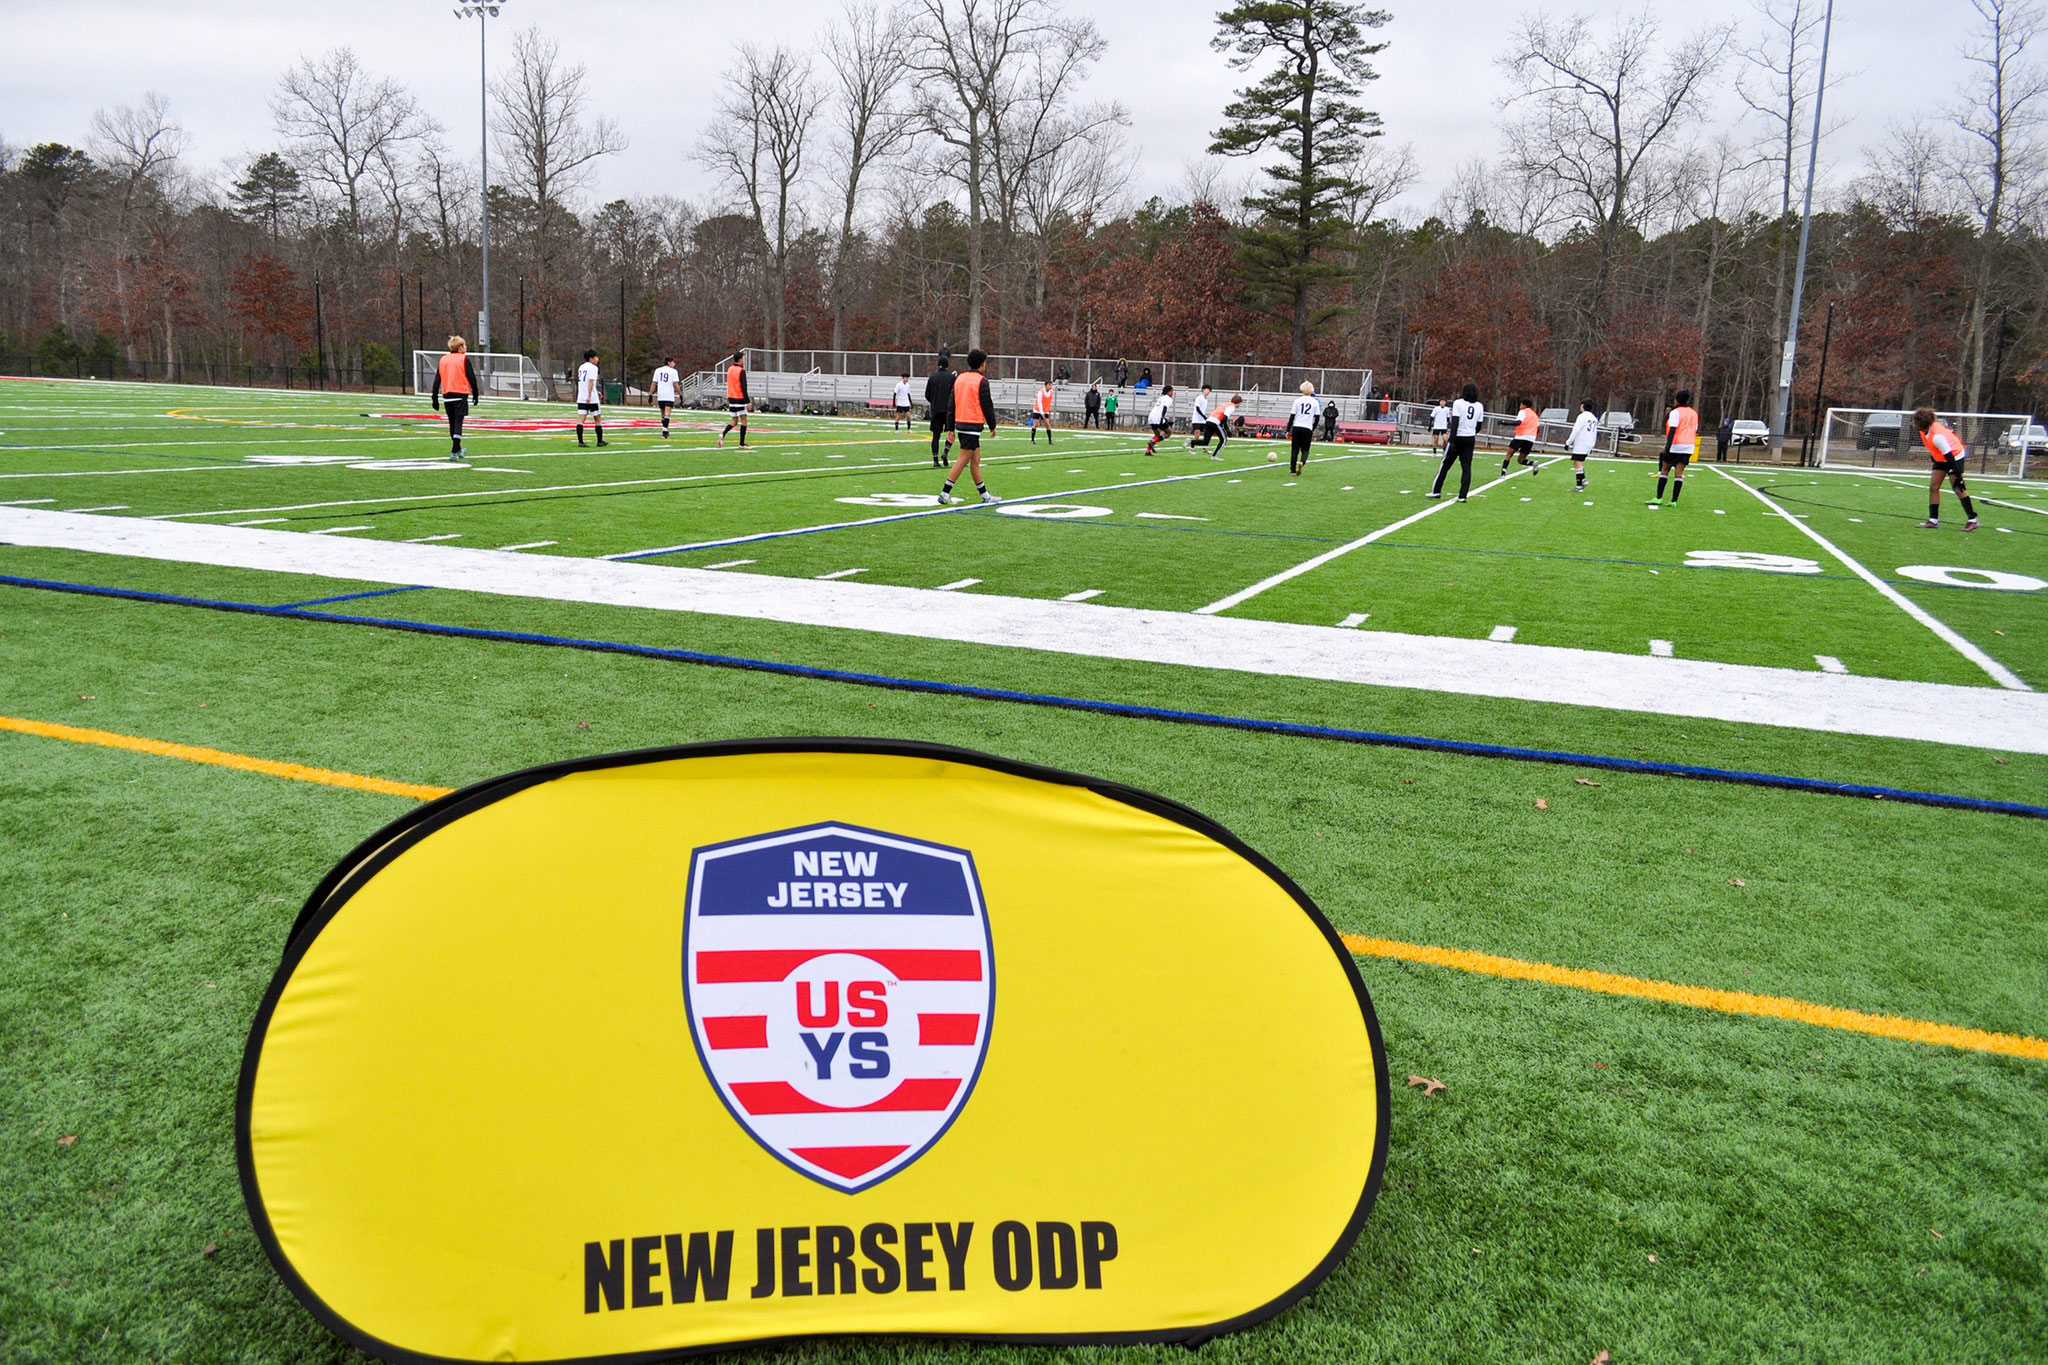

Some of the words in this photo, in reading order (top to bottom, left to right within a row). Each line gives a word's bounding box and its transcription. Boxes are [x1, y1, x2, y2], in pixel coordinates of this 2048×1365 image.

[659, 372, 669, 383] 19
[1300, 402, 1312, 415] 12
[1466, 405, 1475, 420] 9
[793, 850, 878, 877] NEW
[767, 882, 909, 908] JERSEY
[796, 980, 889, 1029] US
[799, 1031, 891, 1081] YS
[584, 1230, 735, 1315] NEW
[751, 1221, 975, 1299] JERSEY
[992, 1220, 1119, 1292] ODP
